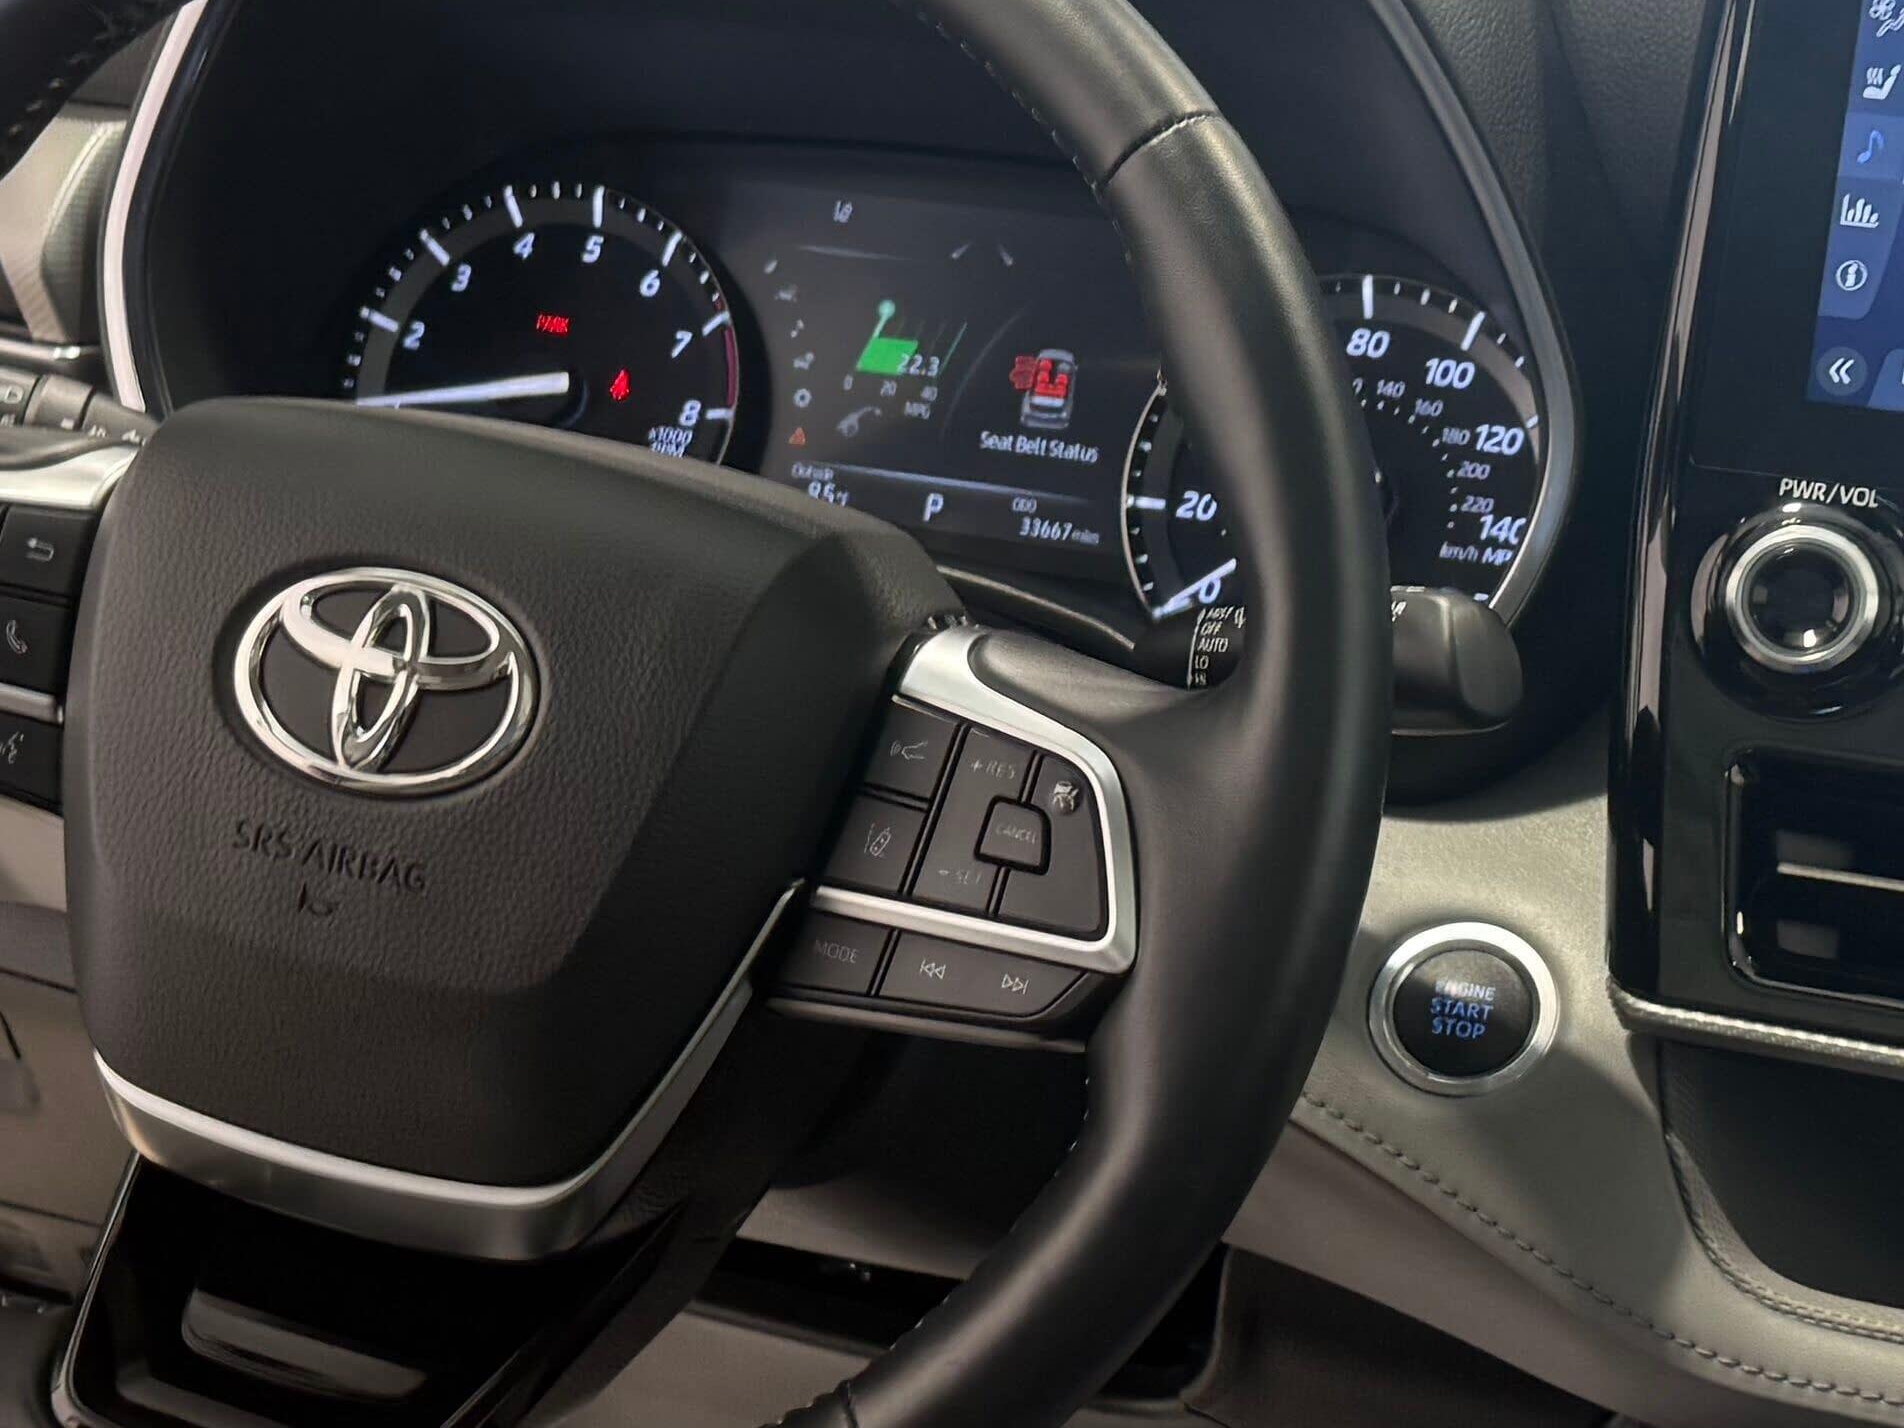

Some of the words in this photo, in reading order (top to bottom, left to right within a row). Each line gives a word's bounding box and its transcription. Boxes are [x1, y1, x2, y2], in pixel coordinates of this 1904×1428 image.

[513, 232, 536, 260] 4
[581, 235, 604, 264] 5
[451, 263, 472, 293] 3
[639, 270, 662, 298] 6
[403, 321, 426, 351] 2
[670, 330, 693, 359] 7
[1346, 327, 1390, 358] 80
[896, 353, 941, 377] 22.3
[1425, 358, 1476, 390] 100
[1376, 379, 1405, 398] 140
[678, 399, 702, 427] 8
[1414, 399, 1444, 417] 160
[980, 430, 1013, 452] Seat
[1015, 437, 1047, 457] Belt
[1049, 442, 1099, 464] Status
[1442, 427, 1471, 446] 180
[1475, 424, 1525, 456] 120
[1457, 461, 1491, 480] 200
[1175, 490, 1218, 522] 20
[1461, 494, 1494, 513] 220
[1779, 476, 1879, 509] PWR/VOL
[924, 493, 944, 522] P
[1019, 516, 1074, 541] 33667
[1198, 575, 1222, 604] 0
[1197, 638, 1229, 653] AUTO
[232, 819, 296, 861] SRS
[1430, 997, 1494, 1020] START
[1431, 1017, 1486, 1040] STOP
